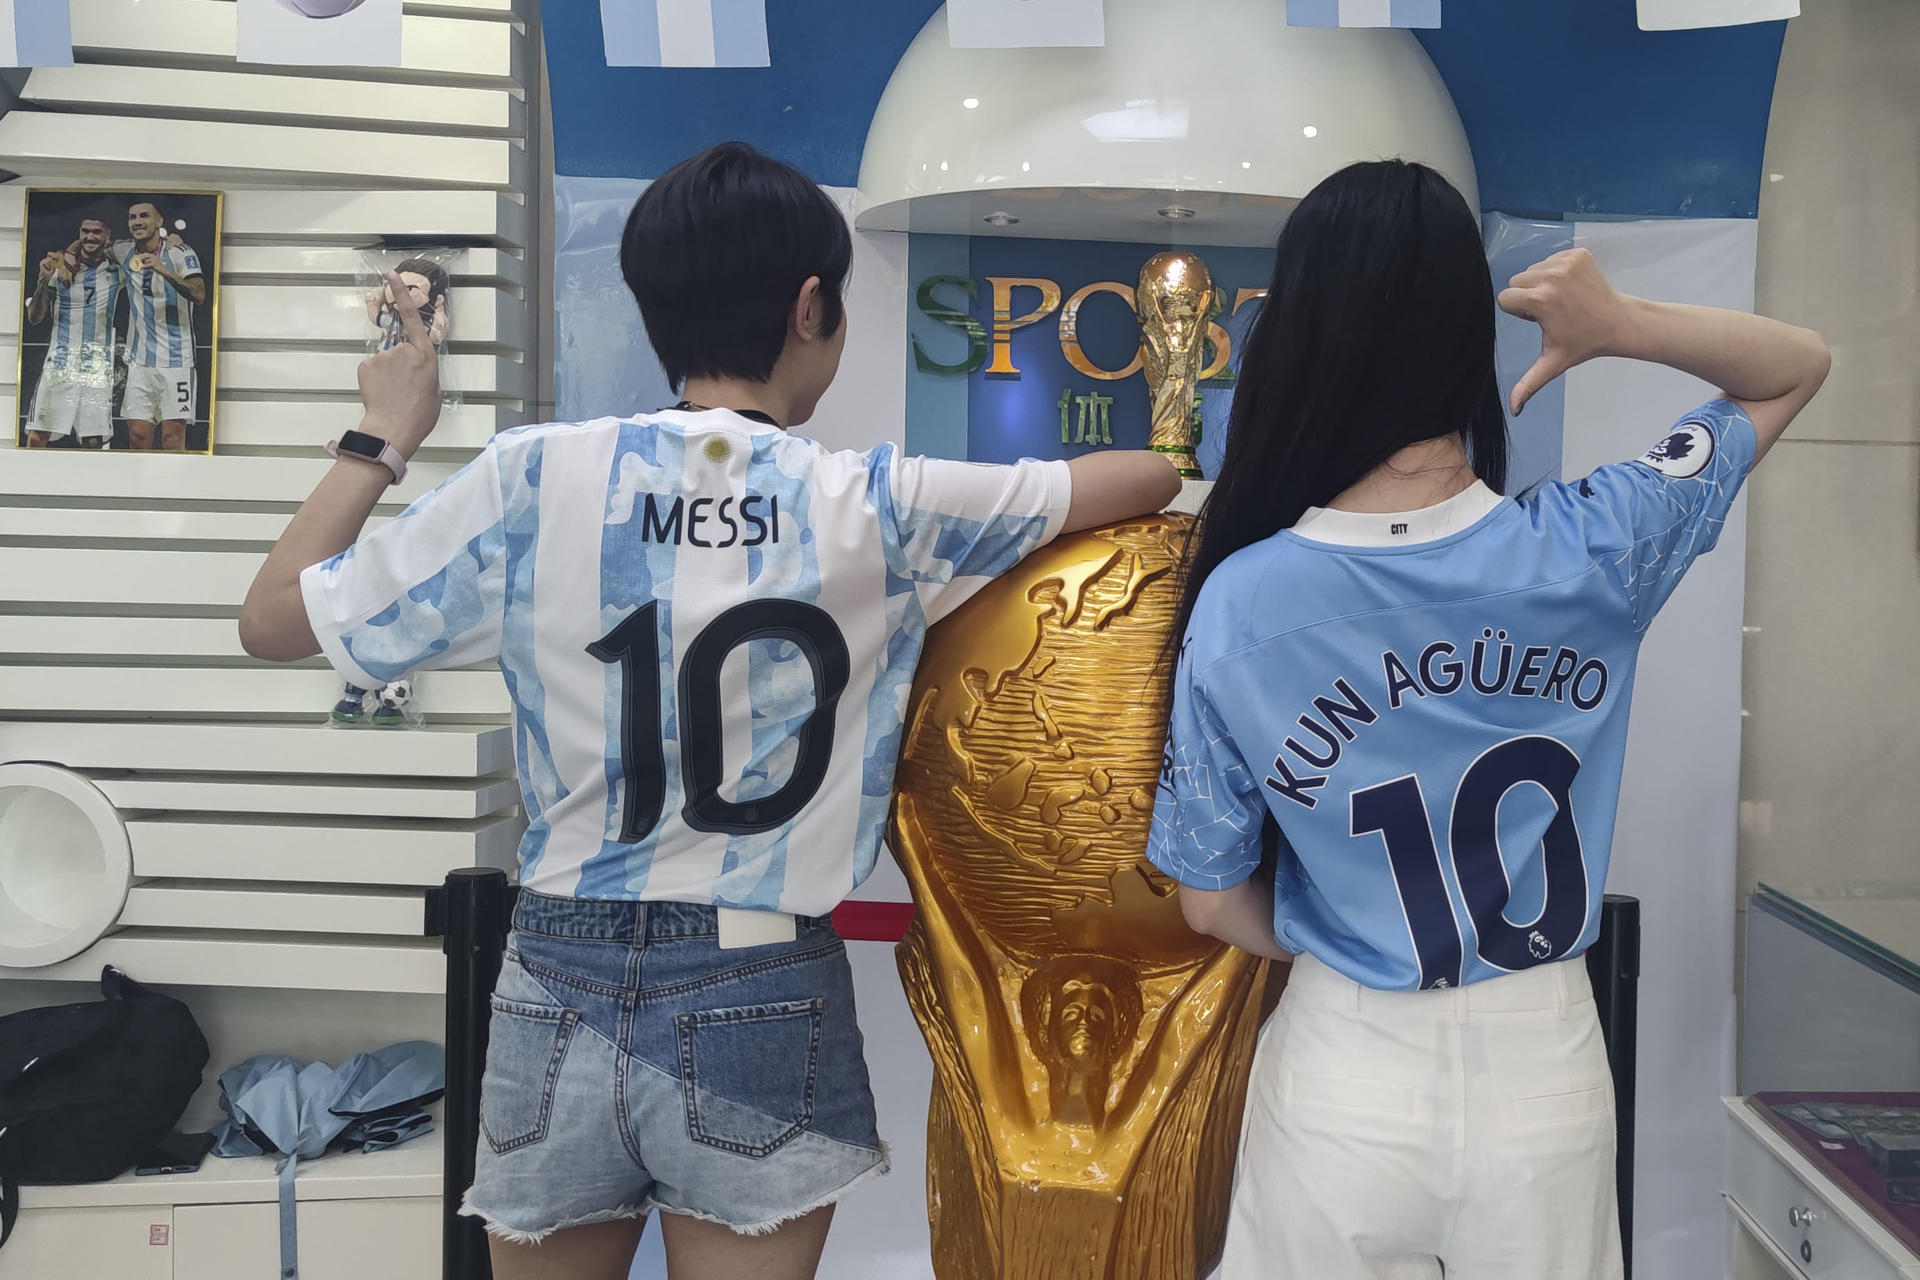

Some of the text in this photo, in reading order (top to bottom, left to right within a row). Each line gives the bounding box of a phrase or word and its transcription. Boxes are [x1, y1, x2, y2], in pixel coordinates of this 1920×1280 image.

[84, 286, 96, 304] 7
[177, 381, 190, 403] 5
[641, 492, 779, 549] MESSI
[1391, 523, 1408, 535] CITY
[583, 597, 851, 844] 10
[1265, 677, 1379, 809] KUN
[1382, 626, 1610, 712] AGÜERO
[1349, 734, 1589, 991] 10
